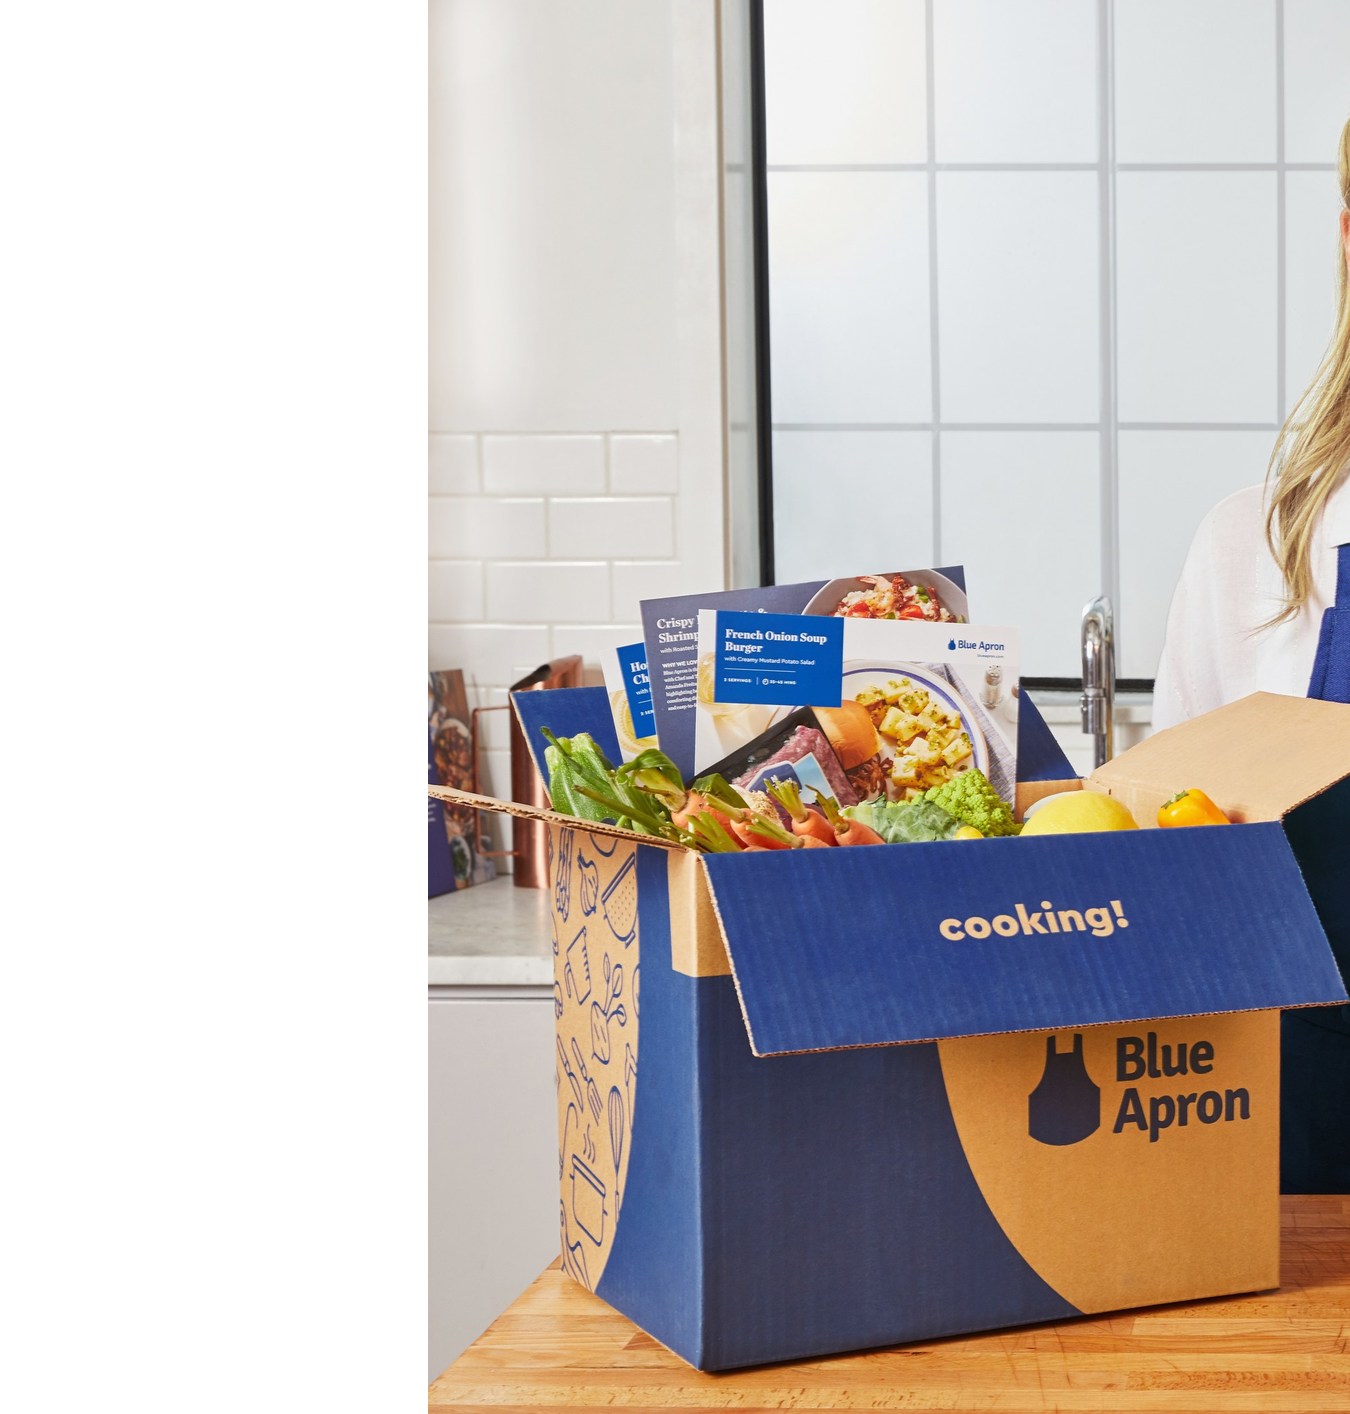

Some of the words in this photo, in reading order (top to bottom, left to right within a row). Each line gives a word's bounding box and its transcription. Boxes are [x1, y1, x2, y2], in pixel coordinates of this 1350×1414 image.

[656, 617, 695, 629] Crispy
[725, 629, 763, 640] French
[765, 631, 798, 642] Onion
[800, 633, 827, 645] Soup
[725, 642, 763, 654] Burger
[958, 640, 977, 649] Blue
[978, 641, 1005, 652] Apron
[939, 900, 1129, 941] cooking!
[1116, 1031, 1215, 1082] Blue
[1112, 1087, 1250, 1143] Apron
